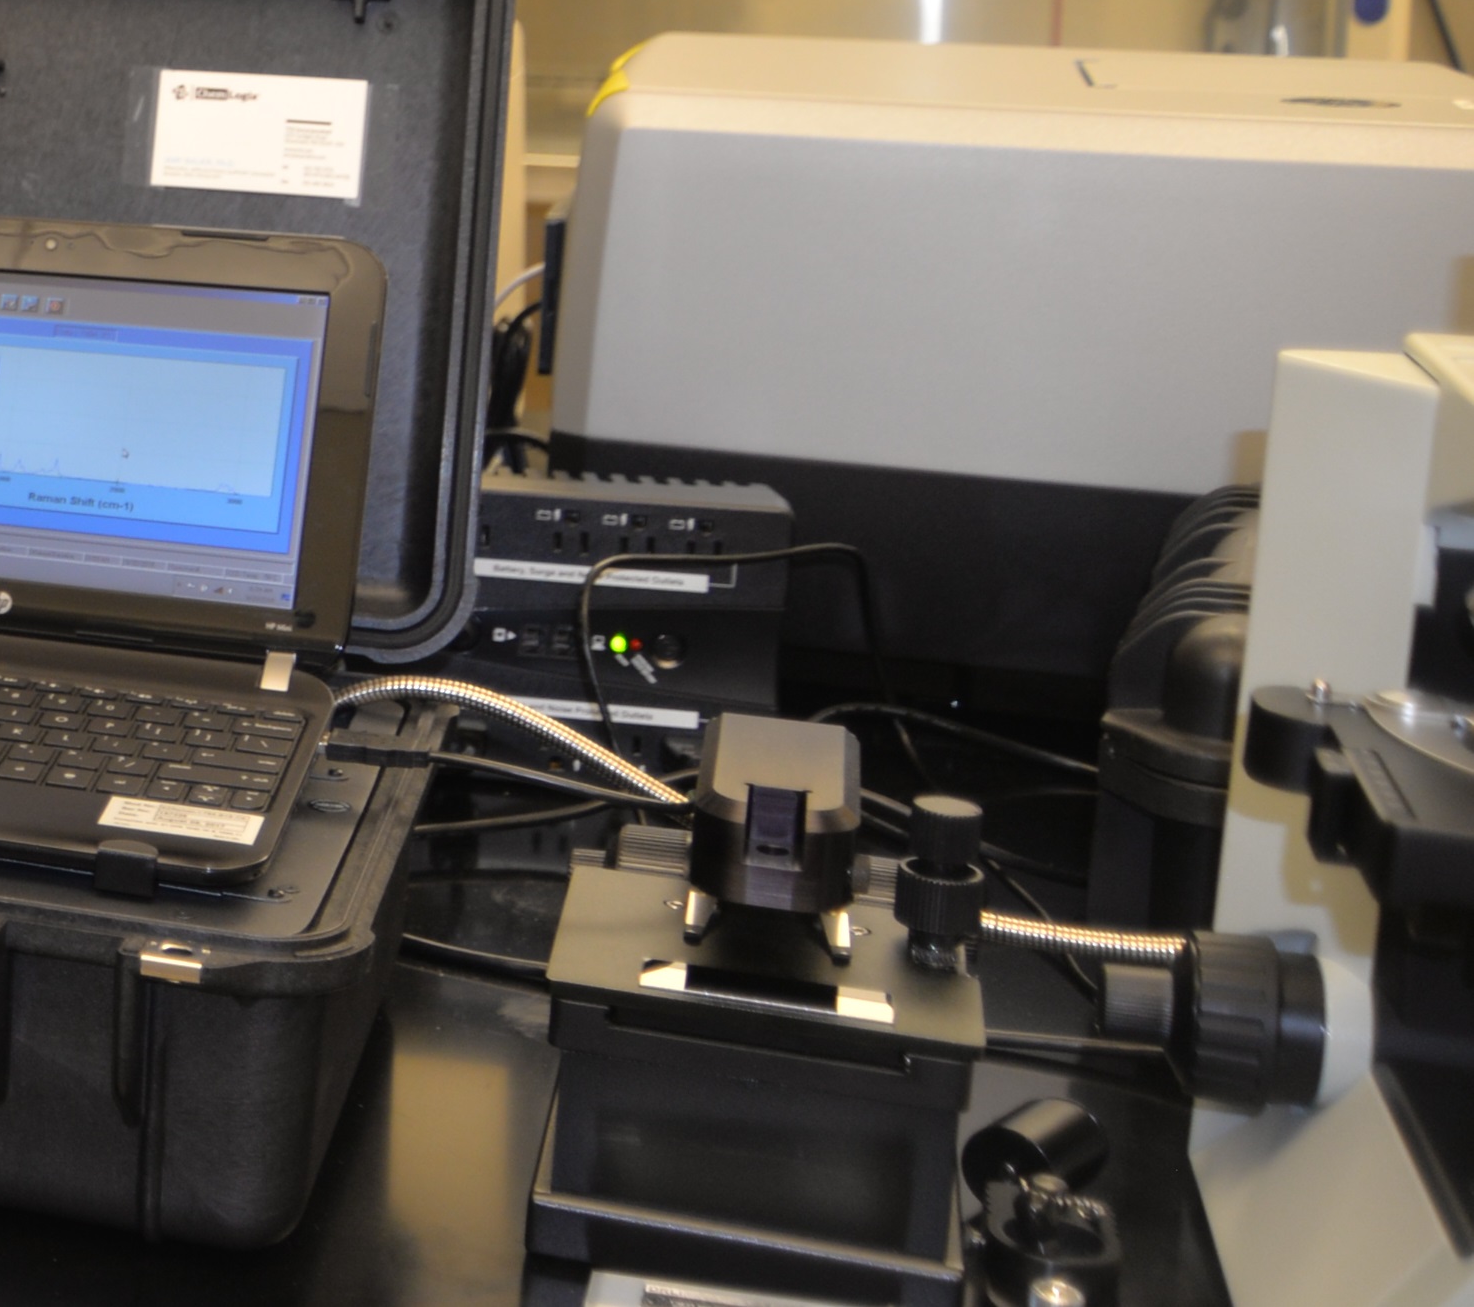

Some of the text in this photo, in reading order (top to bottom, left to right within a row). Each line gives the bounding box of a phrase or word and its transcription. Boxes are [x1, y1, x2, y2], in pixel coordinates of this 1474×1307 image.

[28, 491, 135, 513] Raman Shift (cm-1)
